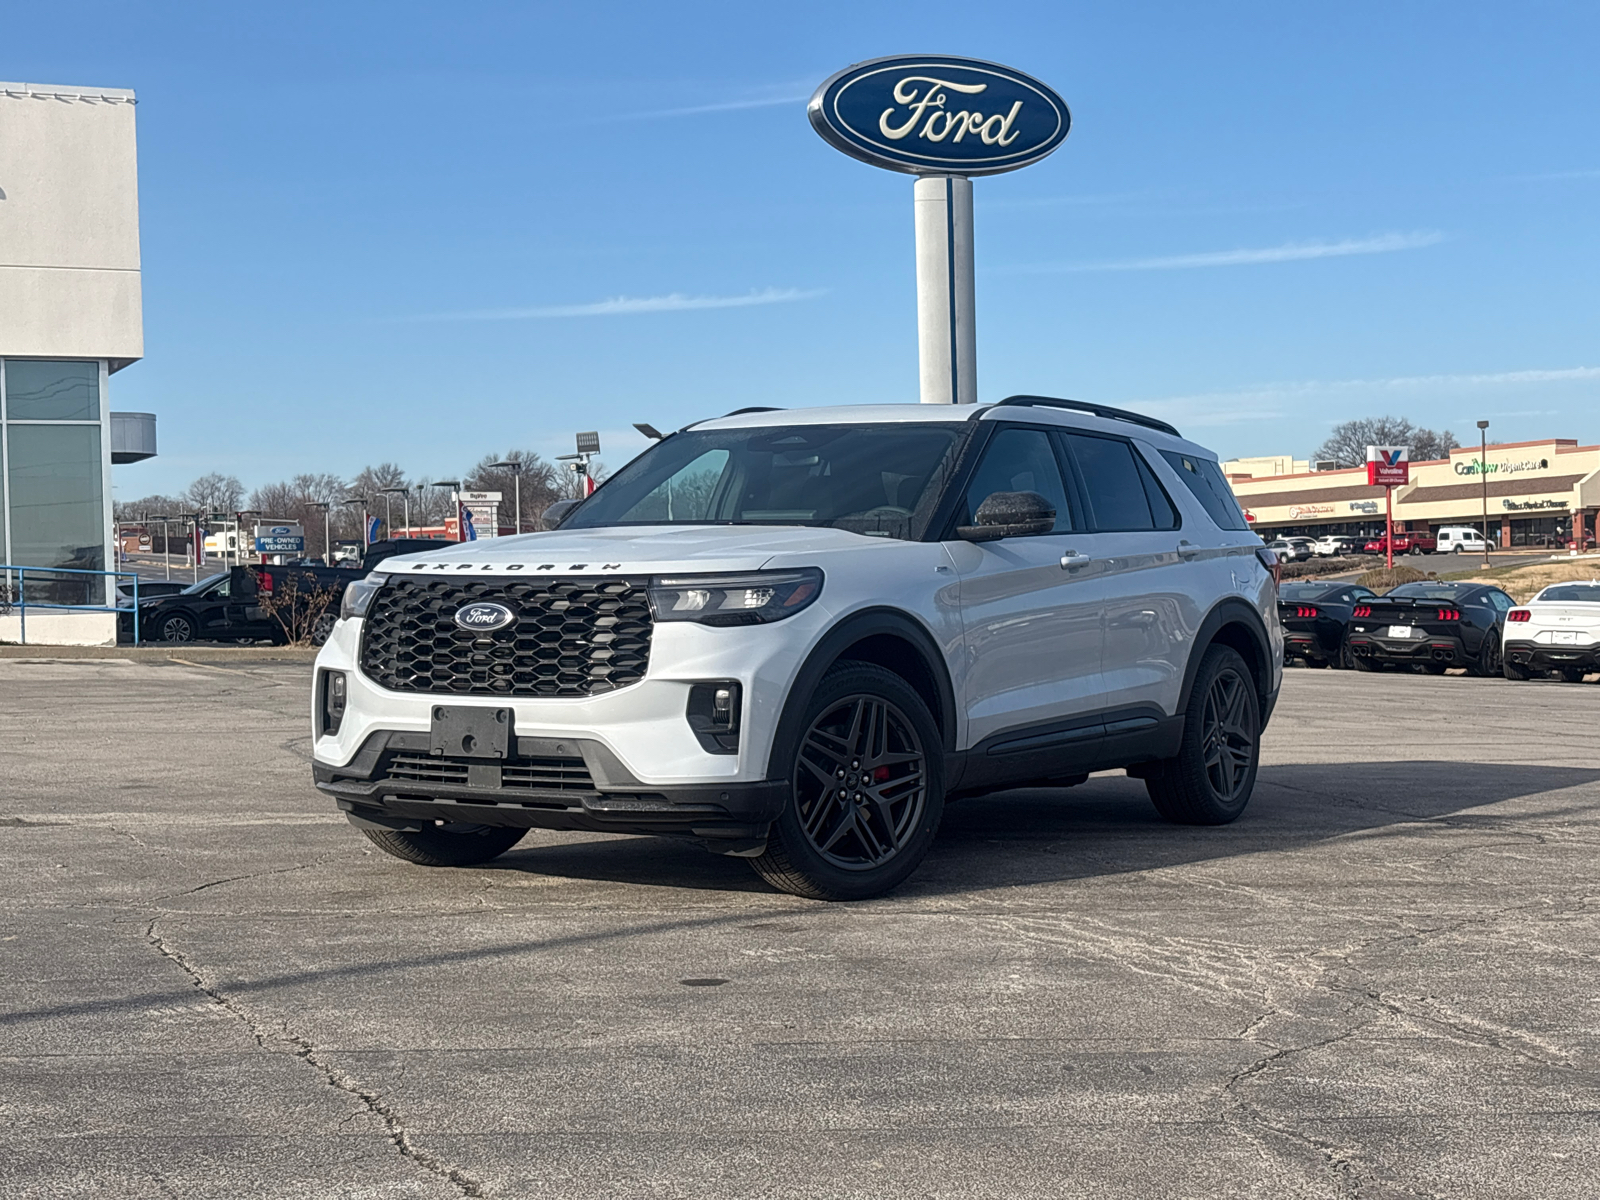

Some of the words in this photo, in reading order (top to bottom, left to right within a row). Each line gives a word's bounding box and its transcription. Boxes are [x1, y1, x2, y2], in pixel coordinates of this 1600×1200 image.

[879, 76, 1023, 147] Ford
[412, 563, 622, 571] EXPLORER
[466, 608, 498, 624] Ford
